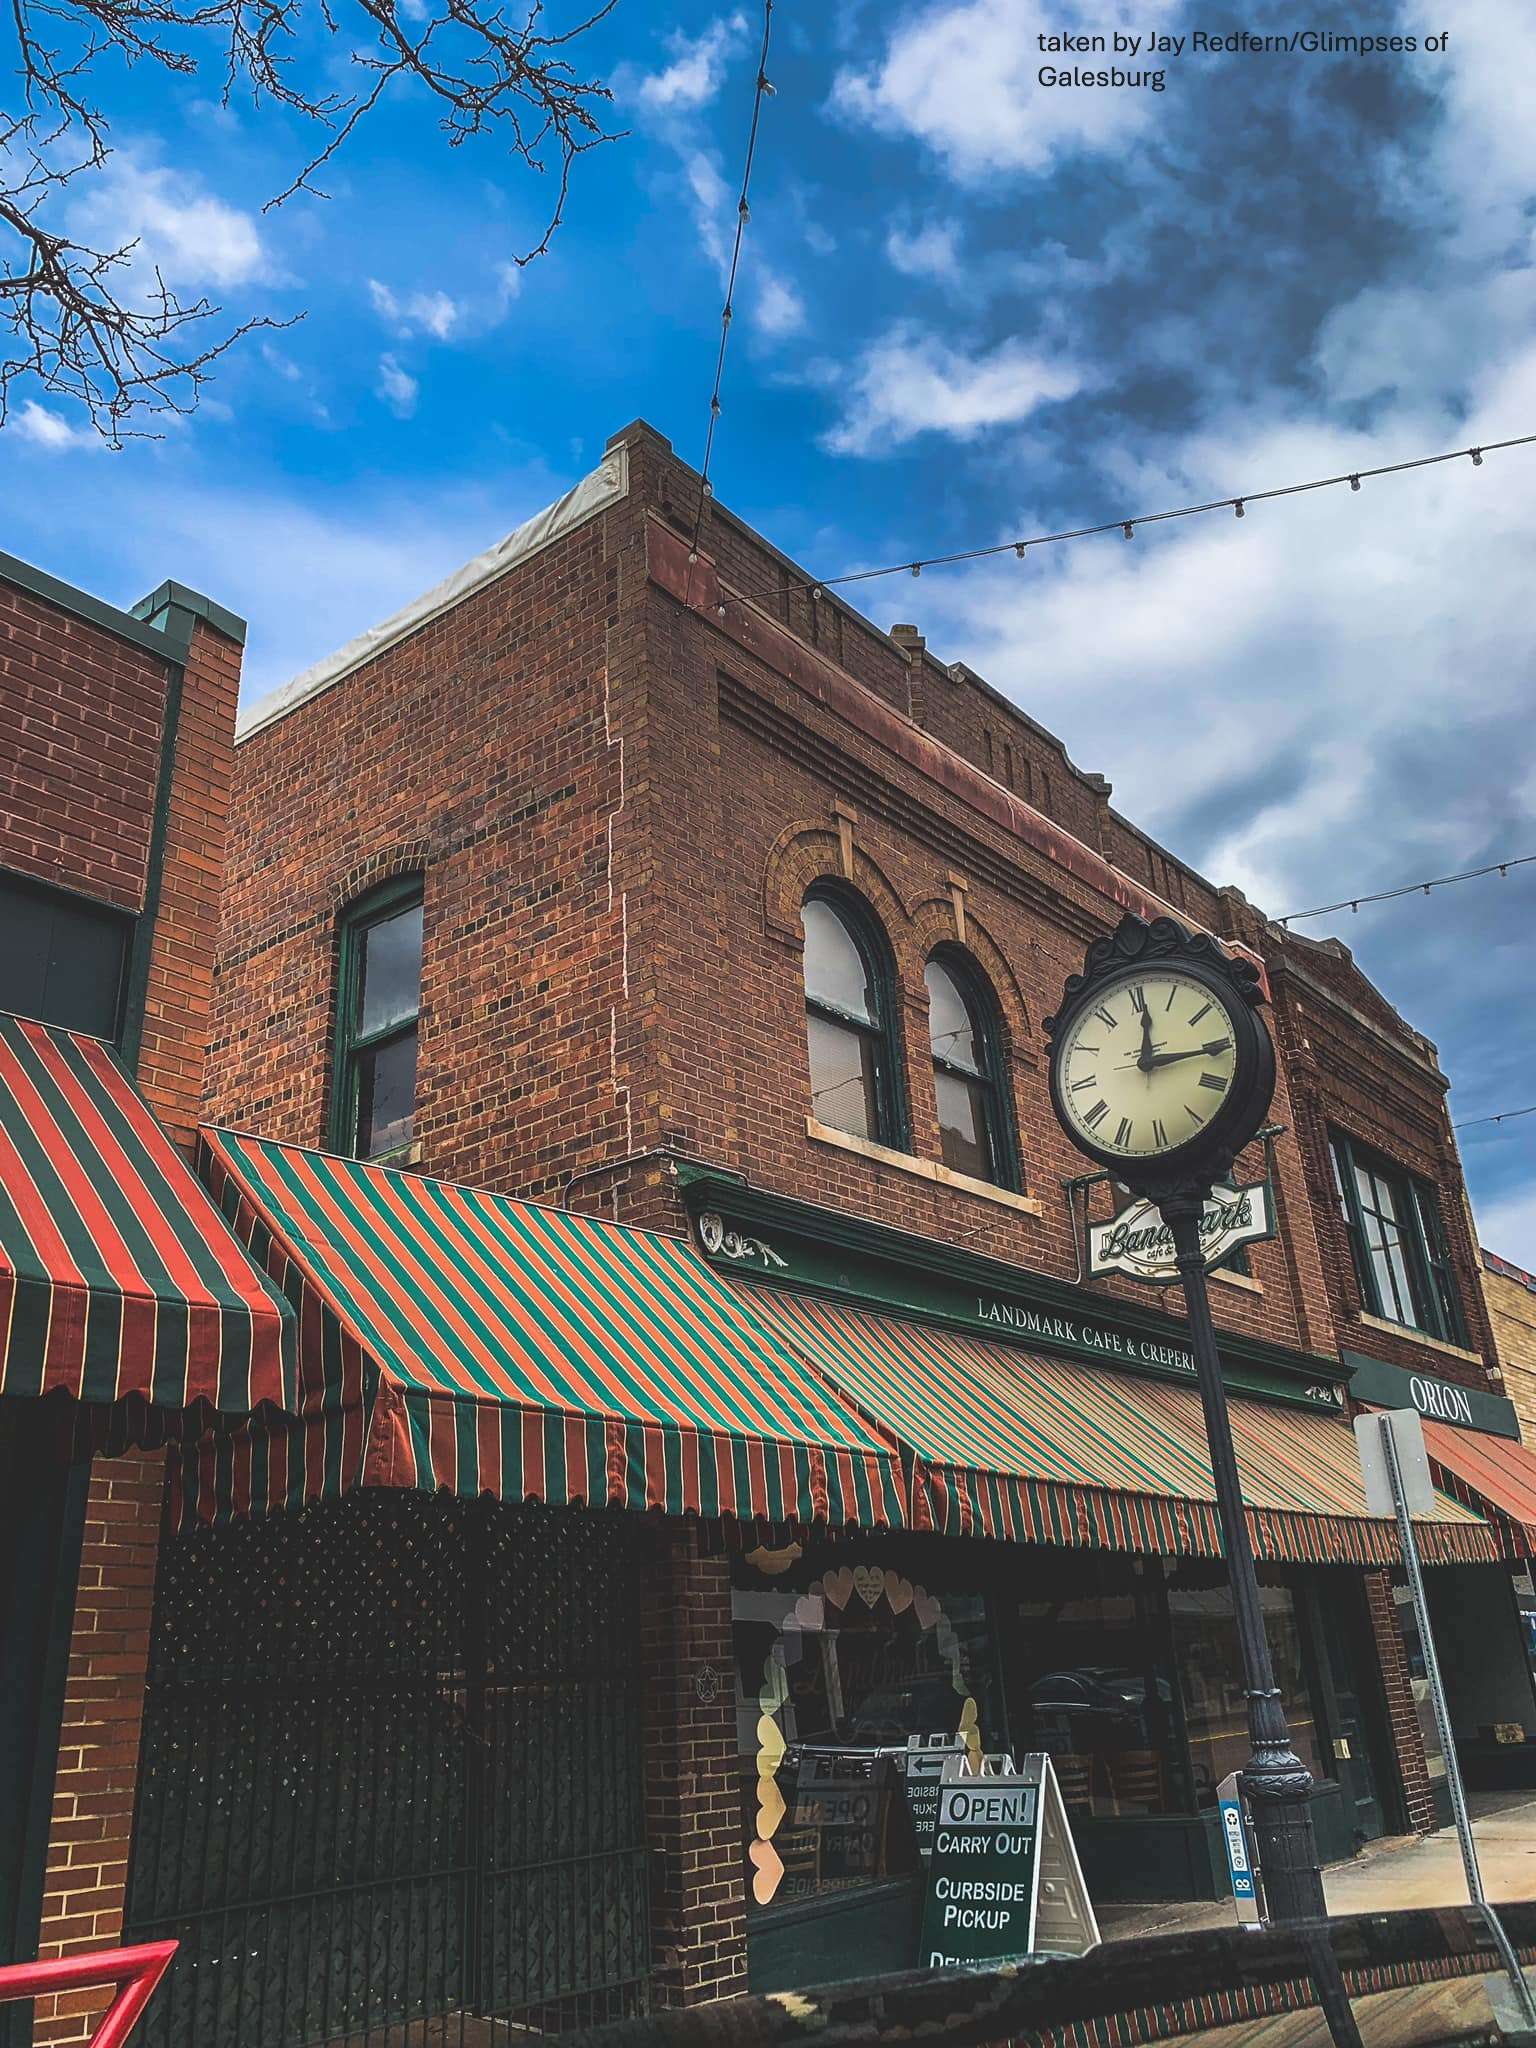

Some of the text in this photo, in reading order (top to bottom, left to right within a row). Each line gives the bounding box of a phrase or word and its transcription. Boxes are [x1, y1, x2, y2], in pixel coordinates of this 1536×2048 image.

[977, 1298, 1198, 1371] LANDMARK CAFE & CREPERI
[1410, 1376, 1472, 1423] ORION
[949, 1792, 1027, 1823] OPEN!
[937, 1832, 1032, 1856] CARRY OUT
[935, 1877, 1025, 1902] CURBSIDE
[944, 1906, 1010, 1930] PICKUP
